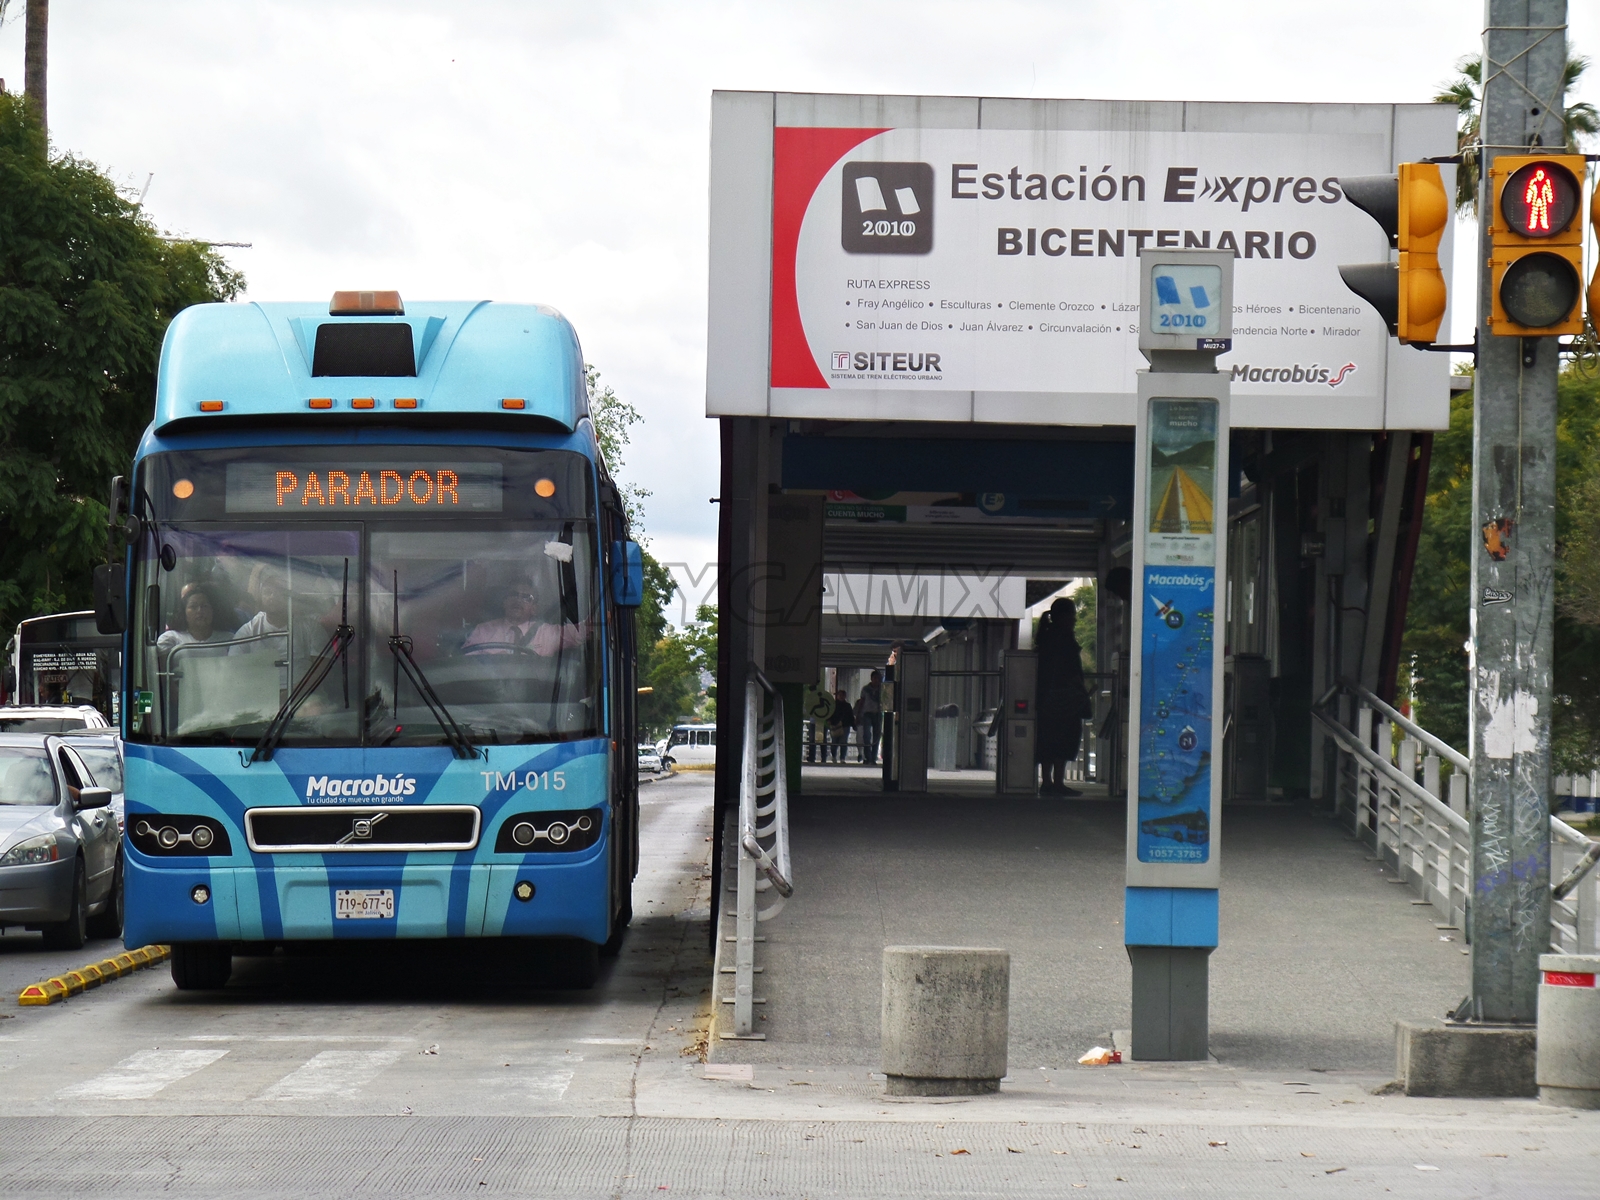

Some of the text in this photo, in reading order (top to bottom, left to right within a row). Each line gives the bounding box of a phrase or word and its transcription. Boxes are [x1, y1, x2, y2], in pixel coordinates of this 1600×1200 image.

[951, 163, 1146, 202] Estación
[862, 220, 916, 237] 2010
[997, 227, 1318, 260] BICENTENARIO
[847, 279, 931, 290] RUTA EXPRESS
[857, 298, 880, 310] Fray
[881, 298, 925, 311] Angélico
[940, 300, 992, 310] Esculturas
[1008, 300, 1056, 311] Clemente
[1058, 301, 1095, 312] Orozco
[1246, 304, 1282, 314] Héroes
[1298, 304, 1361, 315] Bicentenario
[856, 319, 876, 330] San
[878, 320, 903, 330] Juan
[905, 320, 918, 330] de
[921, 320, 943, 331] Dios
[959, 322, 984, 332] Juan
[986, 320, 1024, 332] Álvarez
[1039, 322, 1112, 334] Circunvalación
[1280, 326, 1308, 336] Norte
[1322, 326, 1361, 337] Mirador
[1160, 313, 1207, 328] 2010
[853, 351, 942, 372] SITEUR
[883, 372, 917, 381] ELÉCTRICO
[1230, 363, 1330, 383] Macrobús
[1169, 419, 1199, 427] mucho
[276, 469, 459, 506] PARADOR
[827, 510, 885, 519] CUENTA MUCHO
[1148, 574, 1205, 586] Macrobús
[306, 773, 417, 797] Macrobús
[480, 770, 567, 791] TM-015
[306, 796, 315, 804] Tu
[316, 796, 338, 804] ciudad
[381, 795, 404, 804] grande
[1149, 849, 1203, 859] 1057-3785
[338, 897, 393, 911] 719-677-G
